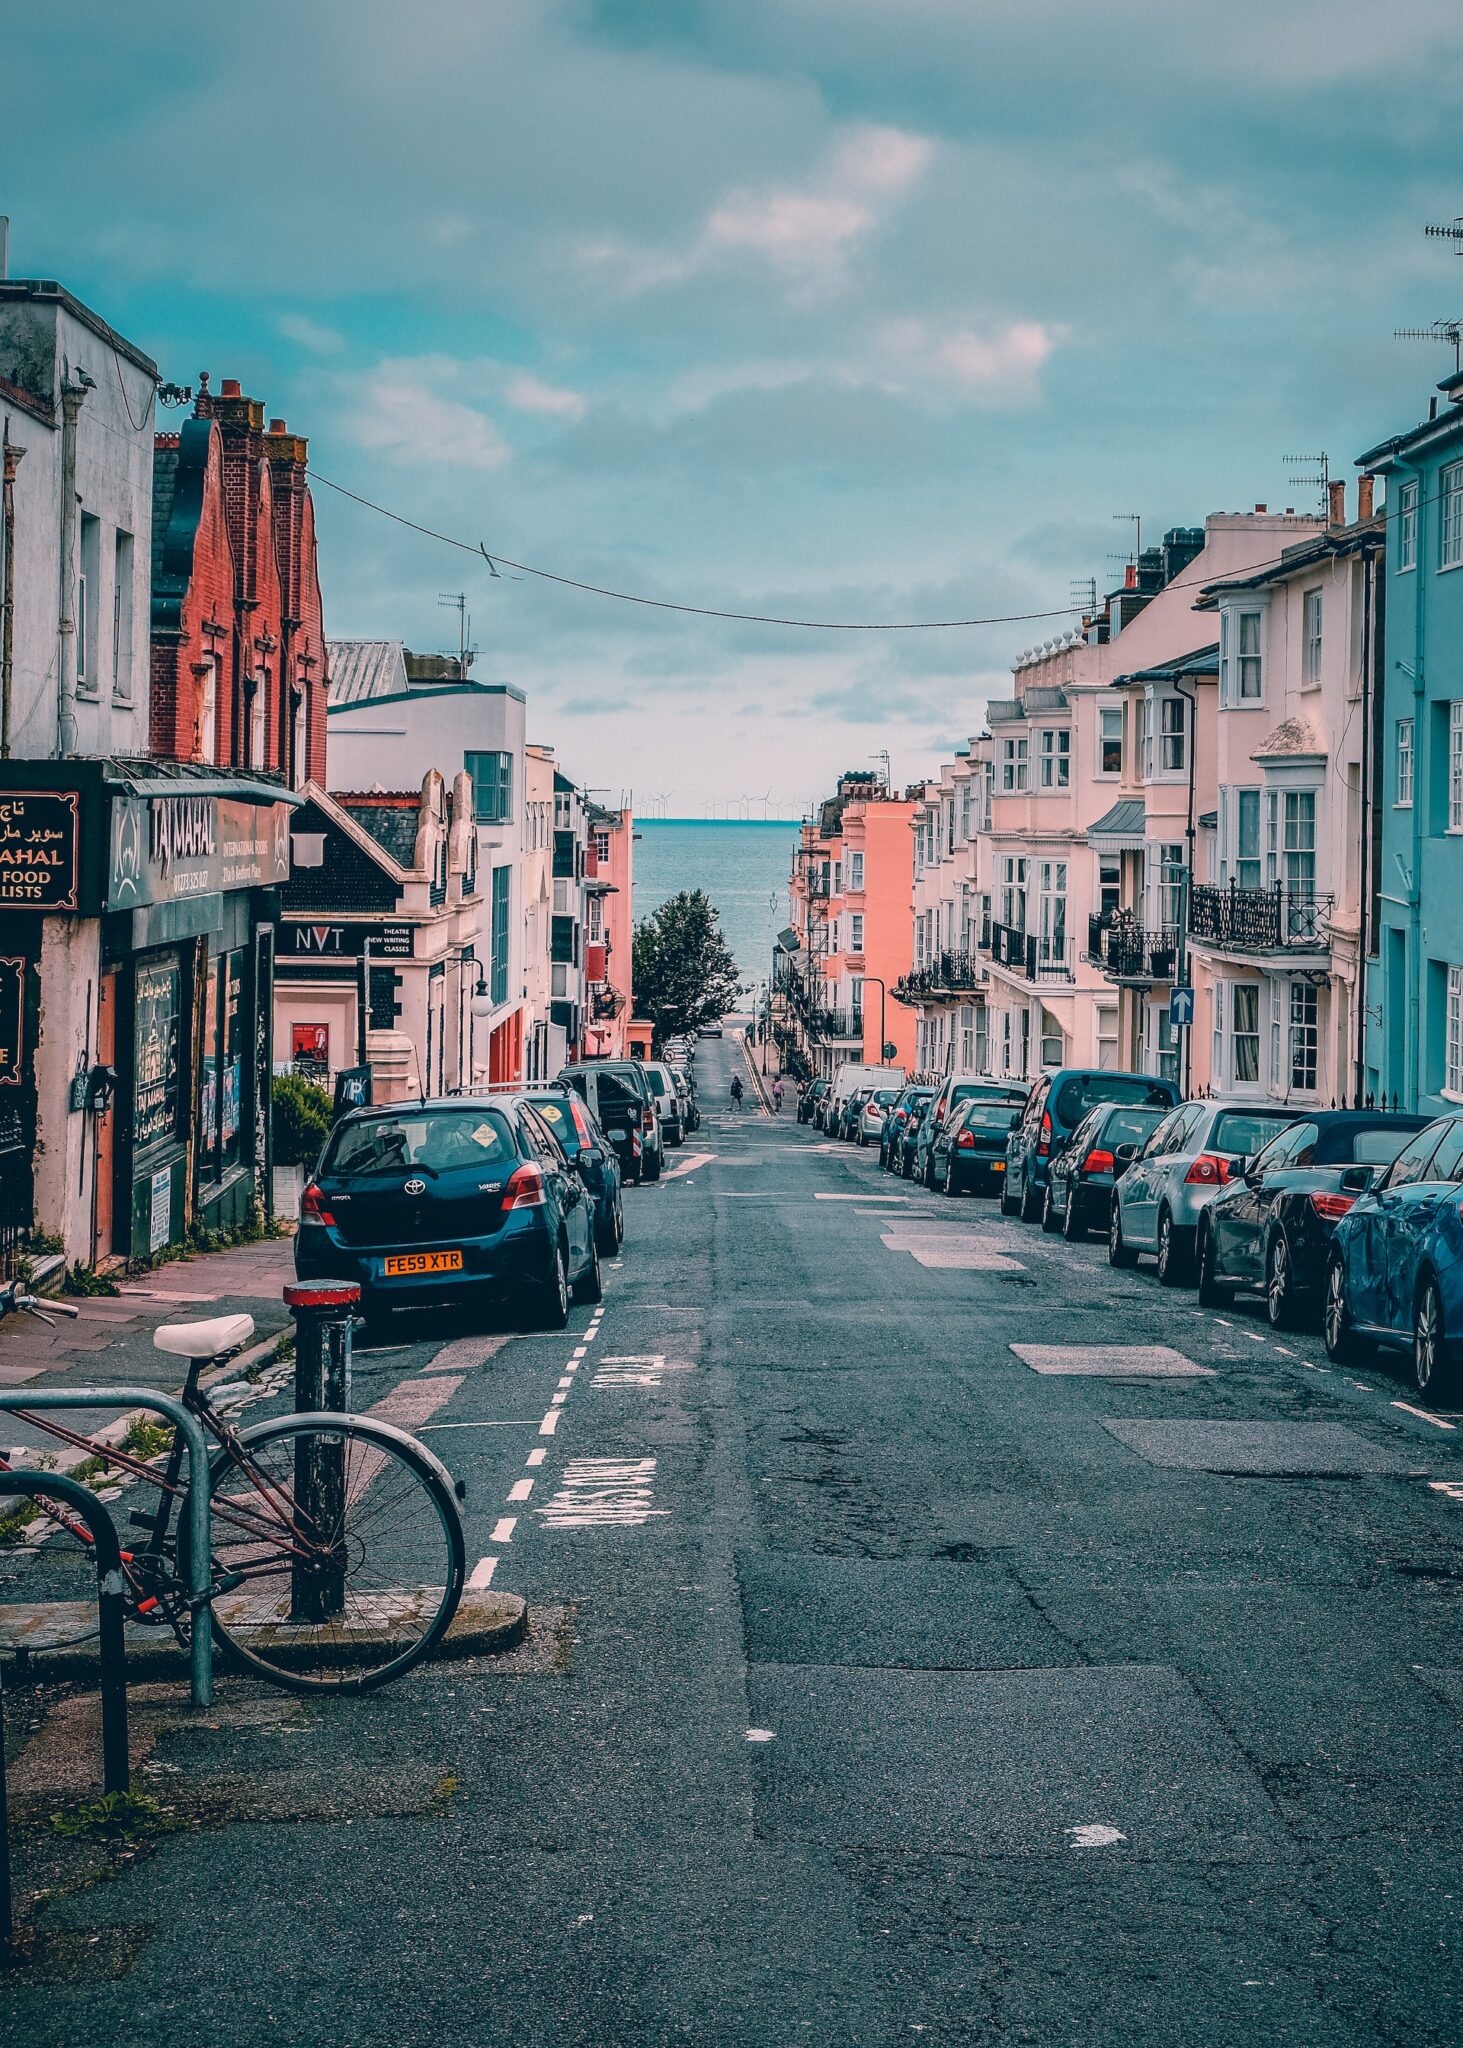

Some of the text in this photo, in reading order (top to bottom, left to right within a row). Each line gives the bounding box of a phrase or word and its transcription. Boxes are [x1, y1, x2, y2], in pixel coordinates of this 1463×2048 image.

[150, 797, 216, 880] TAJ MAHAL
[223, 839, 268, 857] INTERNATIONAL FOODS
[2, 871, 50, 884] FOOD
[0, 886, 42, 898] LISTS
[296, 926, 344, 952] NVT
[387, 1253, 460, 1273] FE59 XTR
[560, 1458, 657, 1487] ONLY
